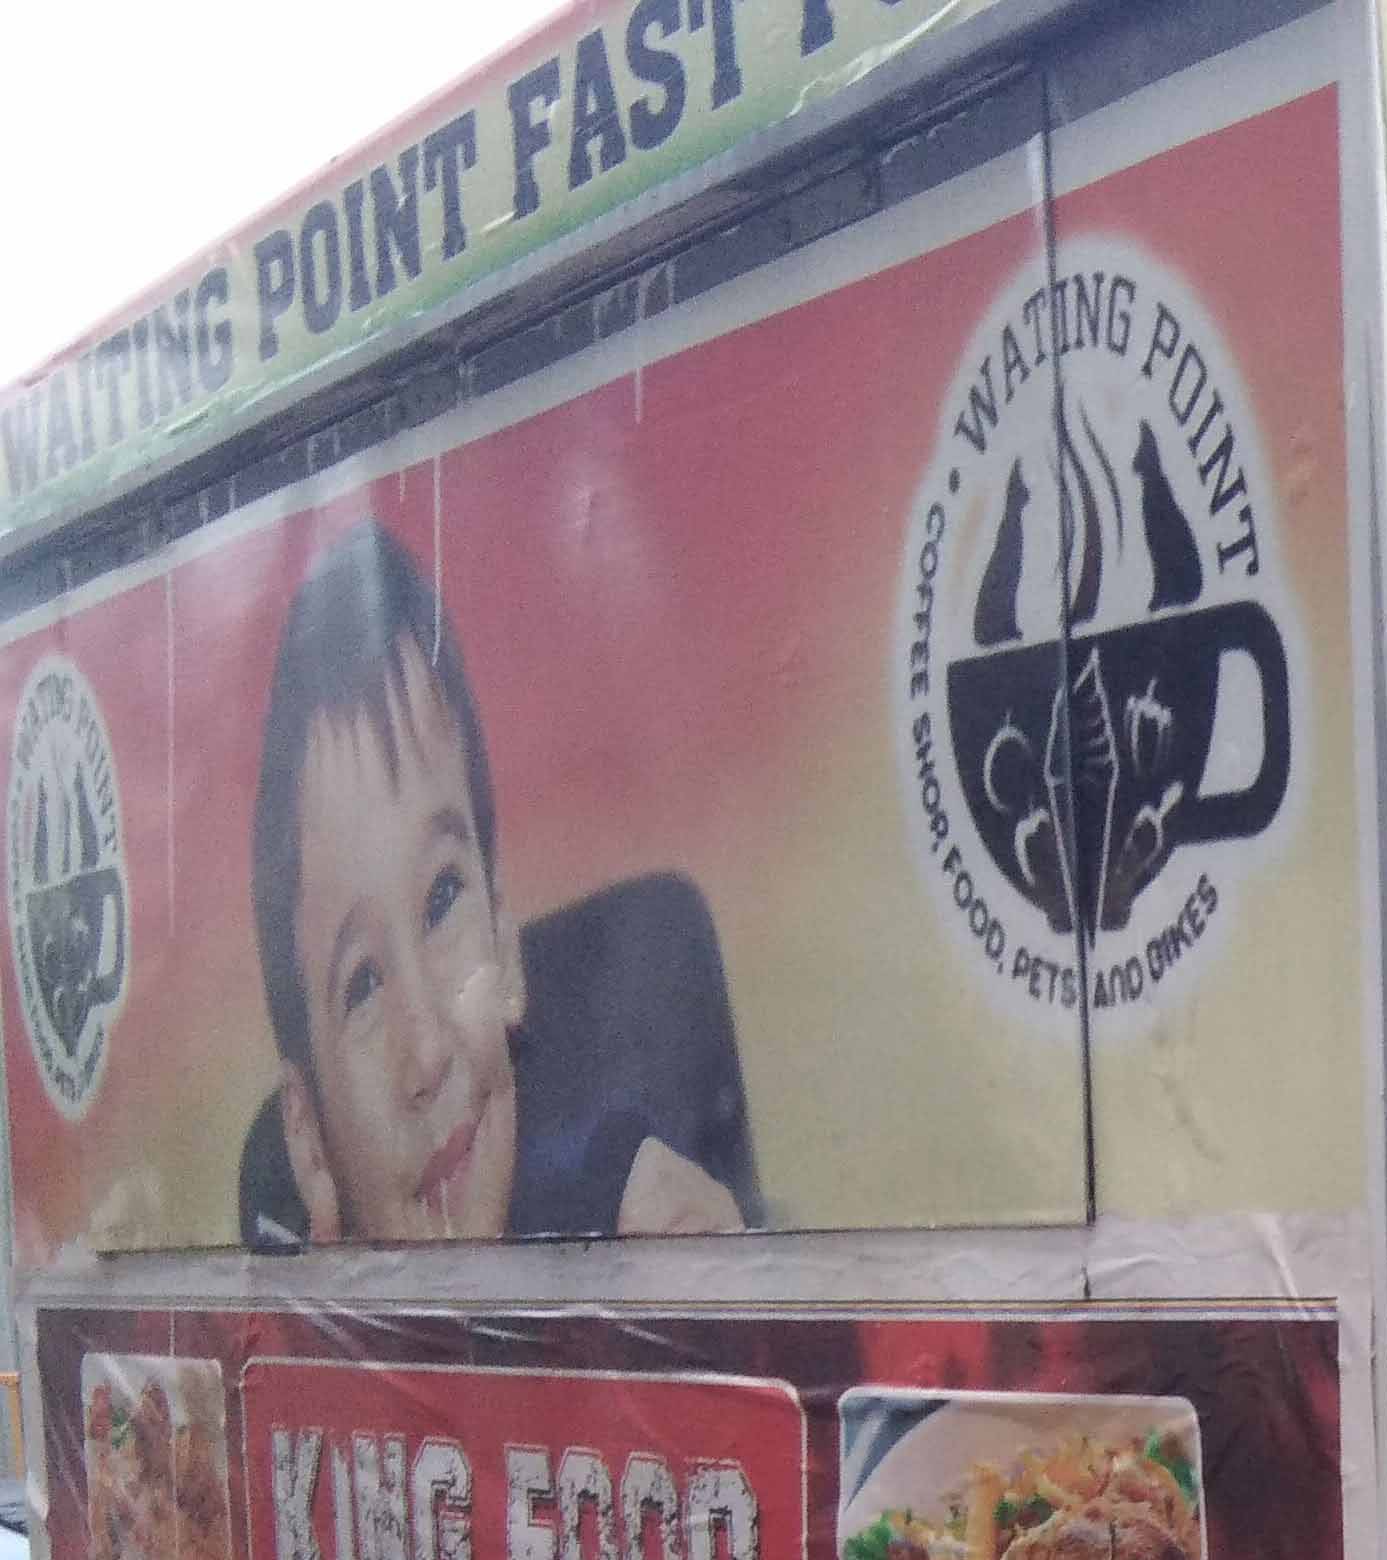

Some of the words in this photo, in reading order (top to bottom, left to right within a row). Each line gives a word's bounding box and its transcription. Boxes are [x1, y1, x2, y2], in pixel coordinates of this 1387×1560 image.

[1, 265, 234, 497] WAITING
[254, 111, 477, 361] POINT
[507, 0, 744, 220] FAST
[1141, 301, 1259, 576] POINT
